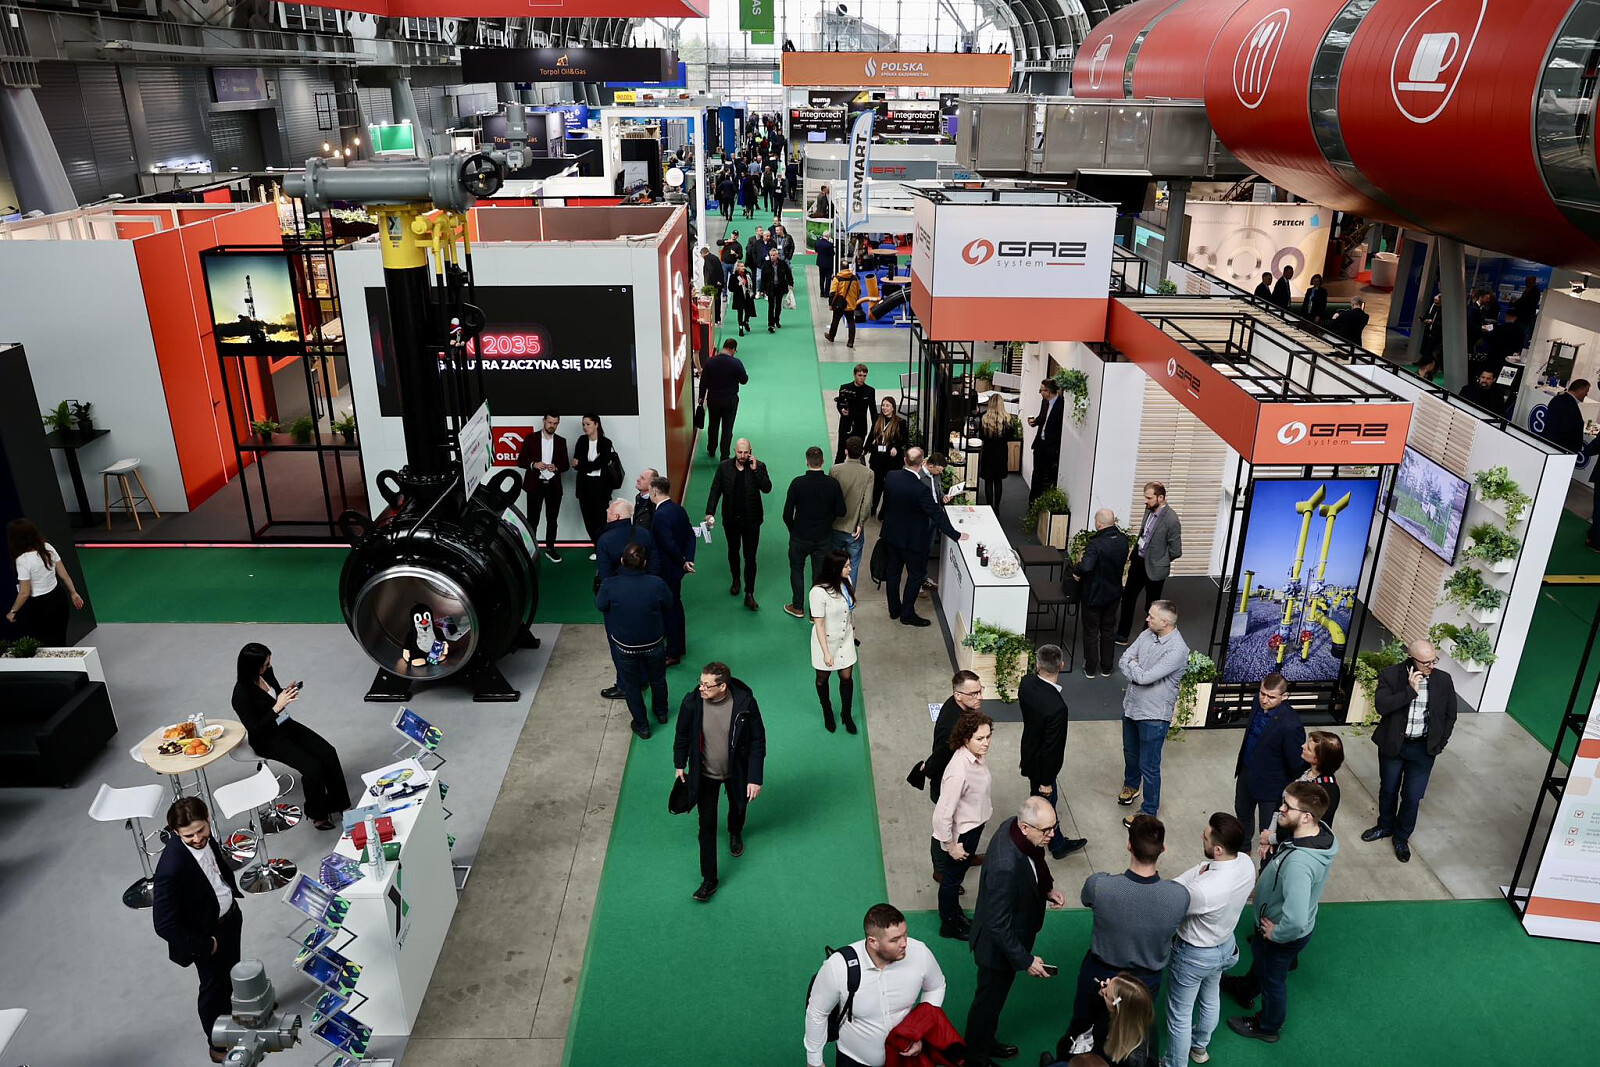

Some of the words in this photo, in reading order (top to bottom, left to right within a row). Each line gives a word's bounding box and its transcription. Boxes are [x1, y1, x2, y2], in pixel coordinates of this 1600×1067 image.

[881, 62, 924, 71] POLSKA
[540, 68, 560, 76] Torpol
[800, 110, 842, 119] integrotech
[893, 111, 935, 120] integrotech
[1273, 219, 1305, 227] SPETECH
[997, 258, 1044, 267] system
[483, 335, 541, 354] 2035
[501, 360, 560, 370] ZACZYNA
[562, 359, 582, 371] SIĘ
[584, 356, 613, 369] DZIŚ
[1307, 437, 1349, 446] system
